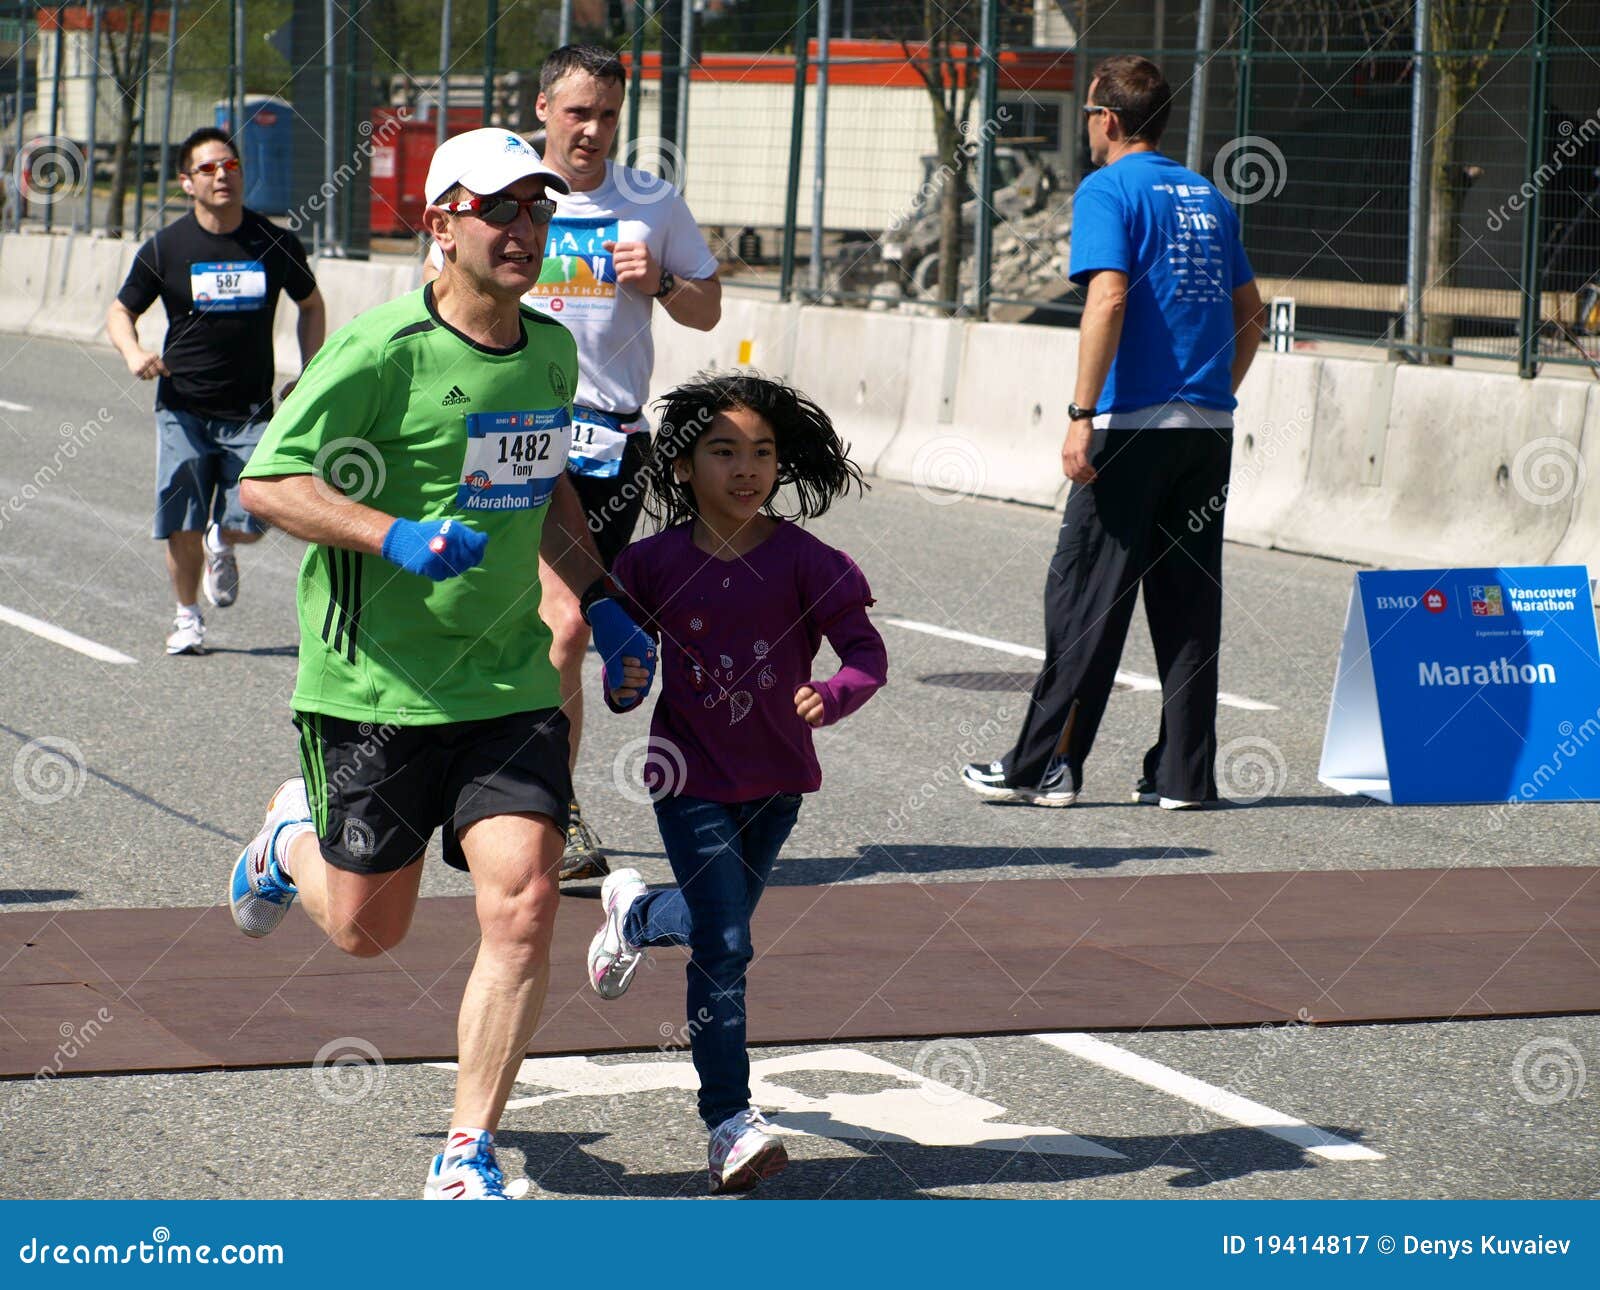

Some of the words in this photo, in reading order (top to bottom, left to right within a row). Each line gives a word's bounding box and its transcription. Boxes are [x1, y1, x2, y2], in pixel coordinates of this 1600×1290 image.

[216, 274, 241, 288] 587
[442, 397, 471, 407] adidas
[498, 433, 551, 464] 1482
[512, 463, 533, 477] Tony
[467, 494, 529, 509] Marathon
[1508, 587, 1577, 600] Vancouver
[1376, 596, 1418, 610] BMO
[1511, 599, 1575, 612] Marathon
[1522, 628, 1545, 638] Energy
[1418, 656, 1557, 686] Marathon
